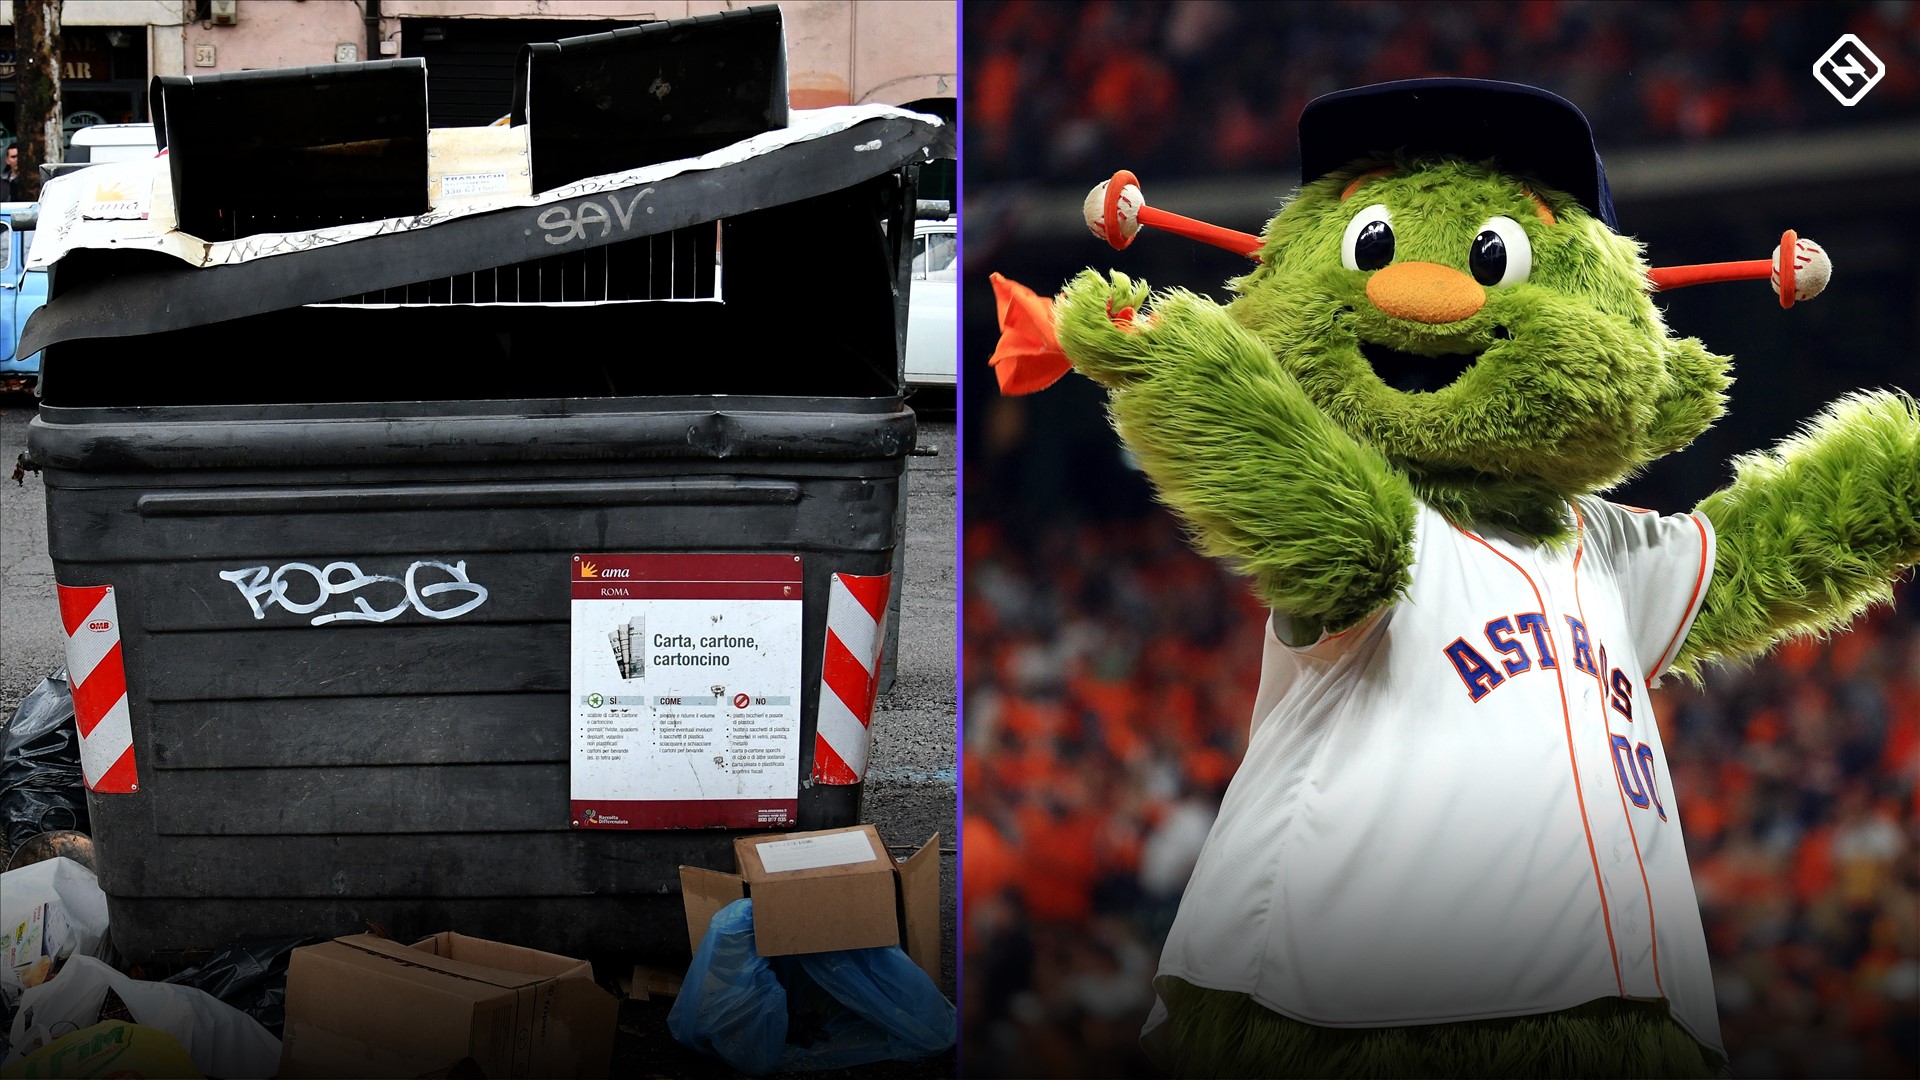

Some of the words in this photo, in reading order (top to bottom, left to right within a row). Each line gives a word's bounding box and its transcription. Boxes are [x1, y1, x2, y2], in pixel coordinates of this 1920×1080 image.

[196, 49, 213, 63] 54
[339, 47, 356, 61] 56
[62, 61, 93, 79] AR
[601, 568, 630, 578] ama
[601, 588, 630, 597] ROMA
[89, 622, 110, 630] OMB
[653, 633, 696, 651] Carta,
[700, 634, 759, 651] cartone,
[653, 652, 730, 667] cartoncino
[660, 697, 682, 706] COME
[755, 697, 767, 706] NO
